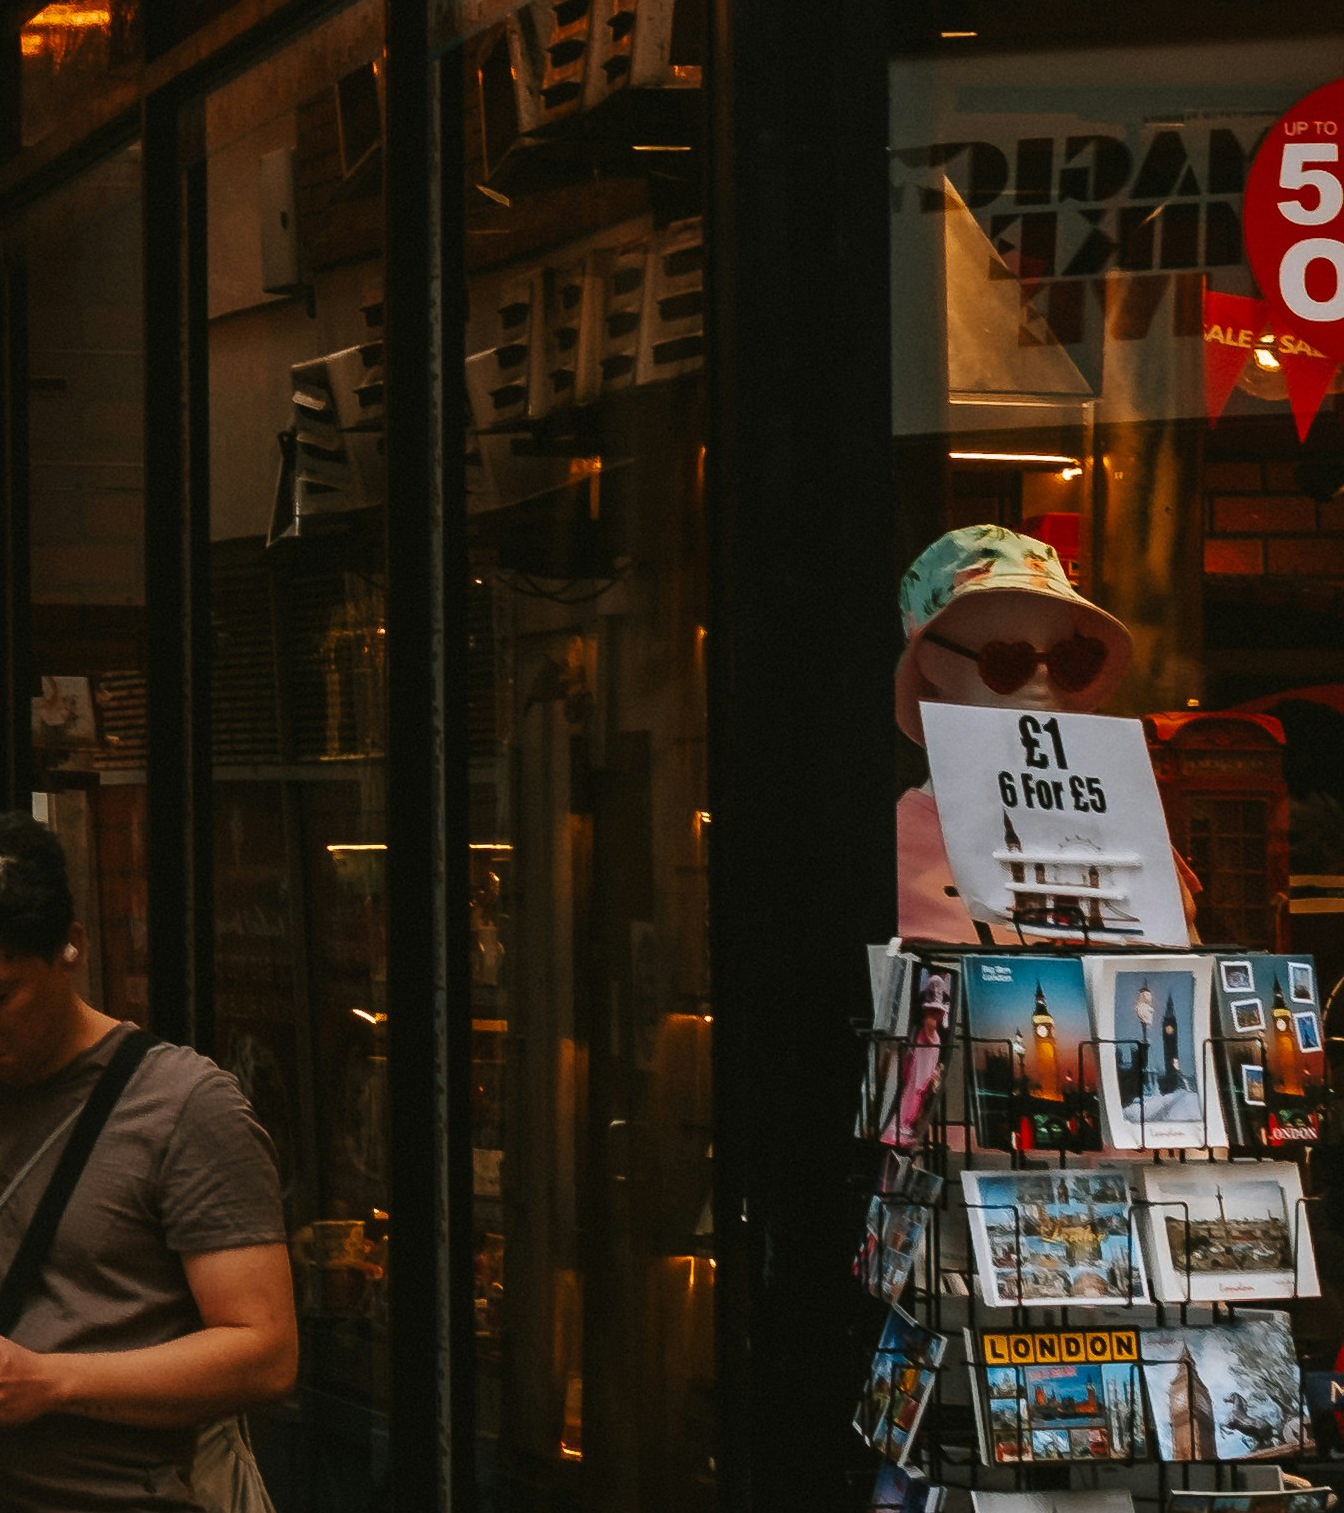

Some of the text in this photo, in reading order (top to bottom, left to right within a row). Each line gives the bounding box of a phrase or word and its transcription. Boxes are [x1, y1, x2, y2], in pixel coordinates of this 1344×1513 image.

[1283, 120, 1339, 137] UP TO
[1204, 324, 1255, 349] ALE
[1017, 714, 1070, 771] £1
[998, 770, 1108, 815] 6 For £5
[1268, 1126, 1319, 1141] ONDON
[989, 1335, 1134, 1361] LONDON
